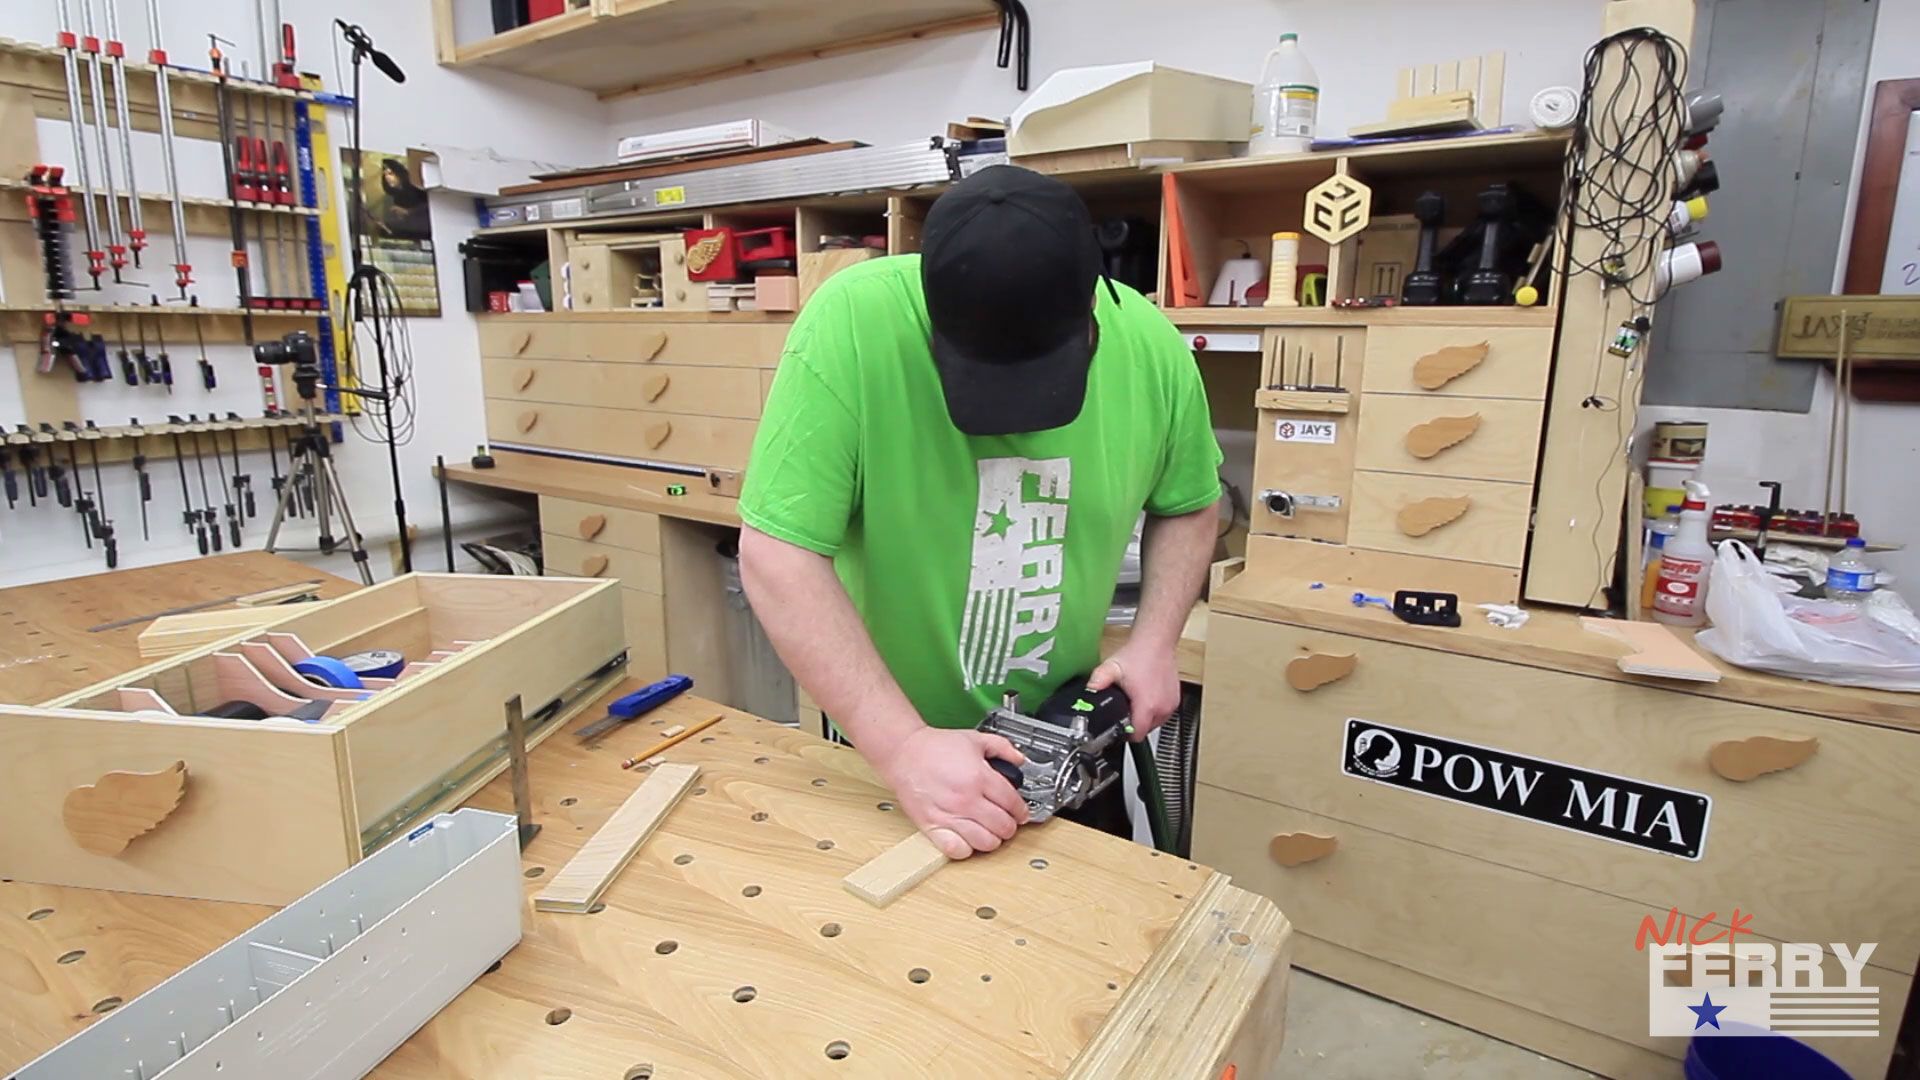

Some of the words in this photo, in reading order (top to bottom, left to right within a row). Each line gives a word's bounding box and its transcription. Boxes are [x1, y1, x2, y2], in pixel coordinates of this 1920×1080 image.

[1300, 423, 1333, 437] JAY'S
[1007, 457, 1071, 679] FERRY
[1411, 743, 1545, 807] POW
[1562, 778, 1688, 847] MIA
